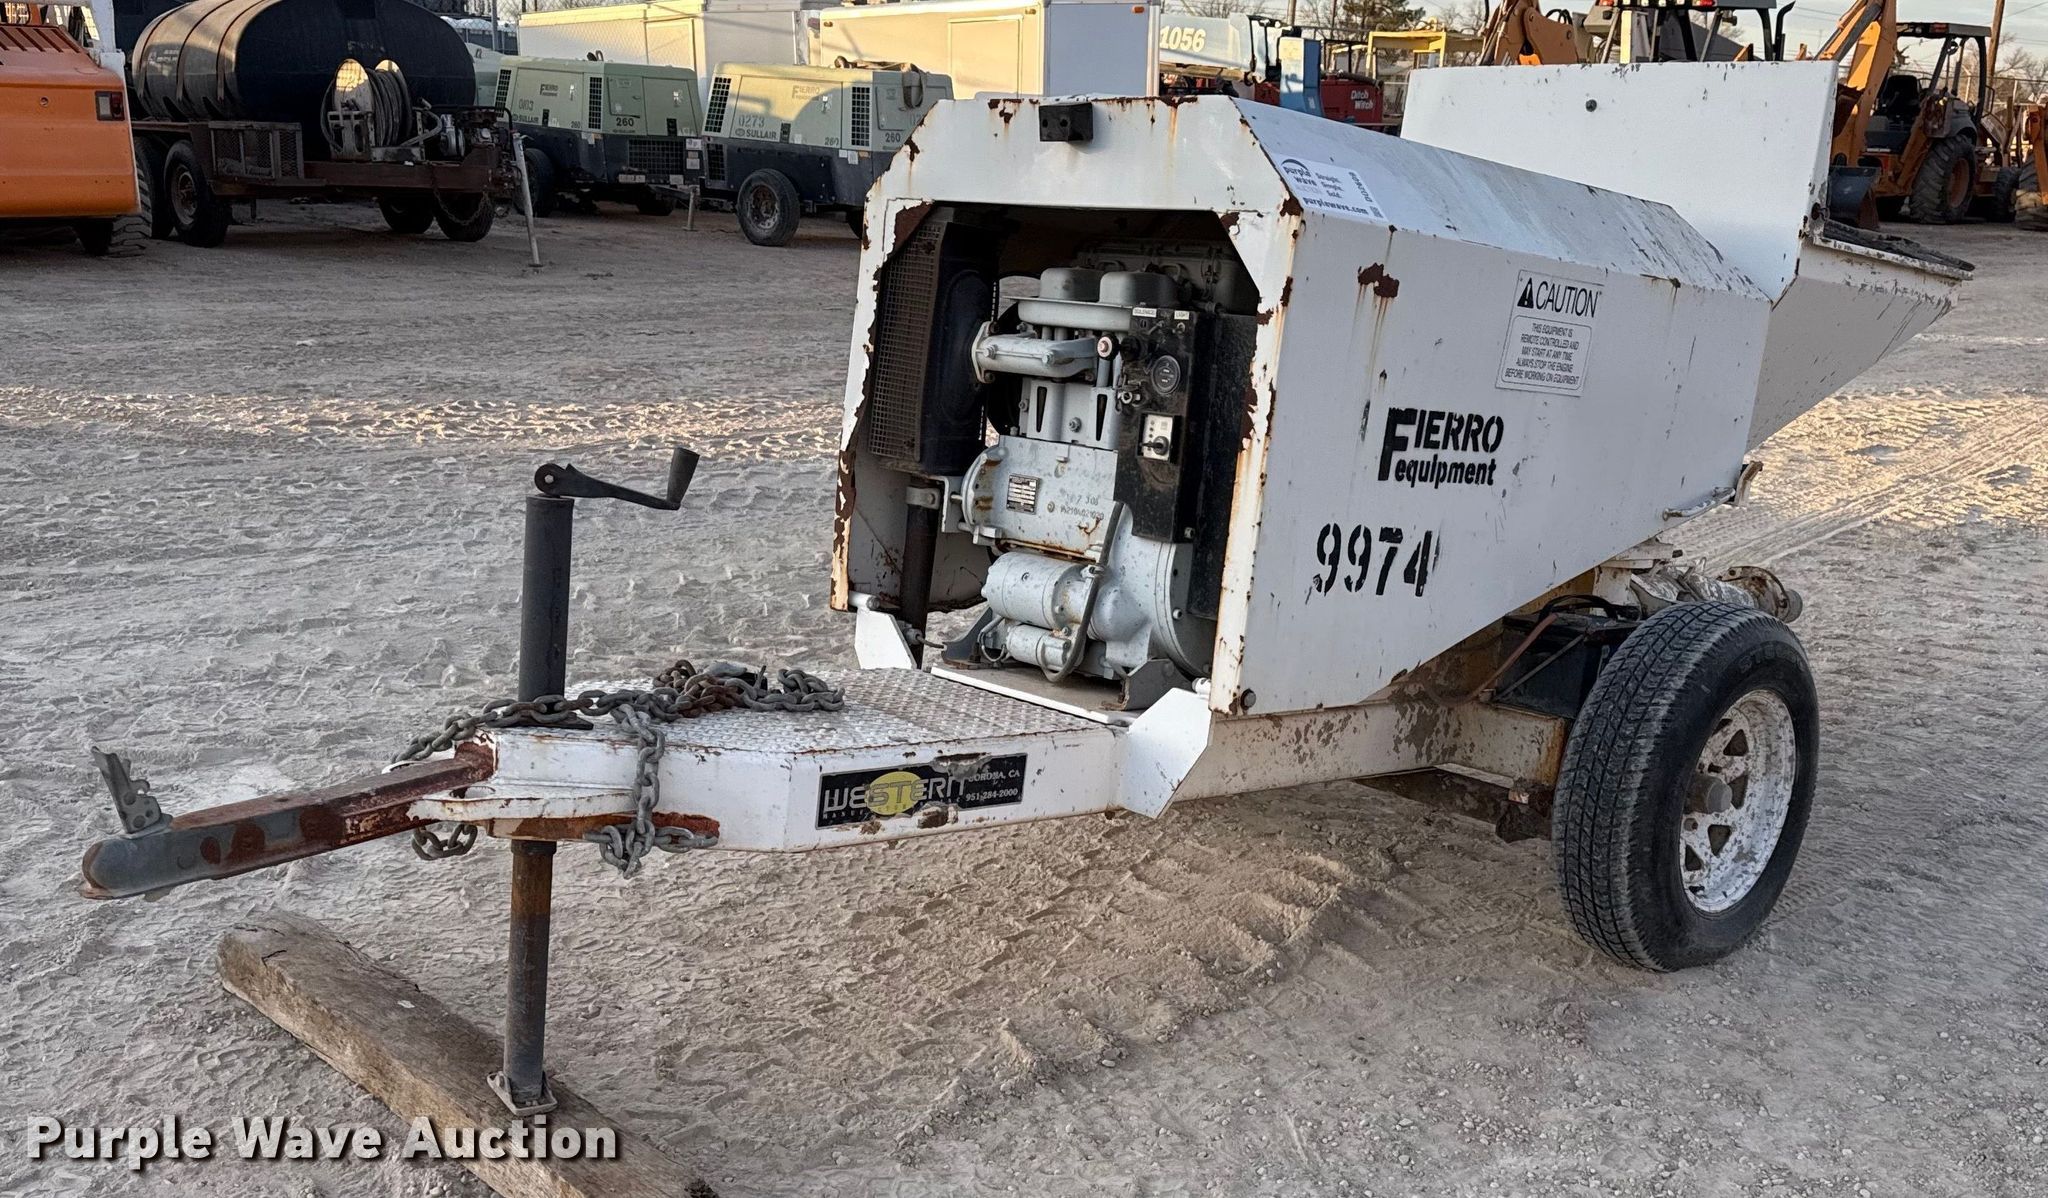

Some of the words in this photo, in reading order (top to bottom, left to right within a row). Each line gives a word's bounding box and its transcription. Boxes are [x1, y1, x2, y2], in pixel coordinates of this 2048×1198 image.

[1160, 25, 1206, 52] 1056
[1351, 90, 1369, 100] Ditch
[1355, 99, 1374, 110] Witch
[616, 117, 634, 127] 260
[739, 114, 765, 128] 0273
[745, 129, 777, 139] SULLAIR
[825, 136, 840, 146] 260
[885, 132, 901, 143] 260
[1283, 166, 1312, 178] purple
[1293, 176, 1318, 187] wave
[1302, 197, 1369, 215] purplewave.com
[1536, 281, 1599, 318] CAUTION
[1532, 323, 1542, 333] THIS
[1542, 324, 1568, 337] EQUIPMENT
[1568, 328, 1574, 338] IS
[1521, 333, 1540, 345] REMOTE
[1540, 336, 1570, 349] CONTROLLED
[1569, 341, 1580, 350] AND
[1521, 345, 1532, 355] MAY
[1531, 347, 1546, 358] START
[1546, 349, 1552, 358] AT
[1552, 350, 1562, 360] ANY
[1562, 351, 1573, 362] TIME
[1516, 357, 1534, 368] ALWAYS
[1534, 359, 1548, 369] STOP
[1547, 361, 1556, 371] THE
[1556, 362, 1574, 373] ENGINE
[1504, 367, 1524, 378] BEFORE
[1524, 370, 1546, 381] WORKING
[1546, 372, 1553, 382] ON
[1552, 373, 1580, 385] EQUIPMENT
[1378, 407, 1505, 481] FIERRO
[1395, 454, 1497, 489] equipment
[1312, 523, 1433, 597] 9974
[1008, 769, 1020, 778] CA
[823, 778, 965, 812] WESTERN
